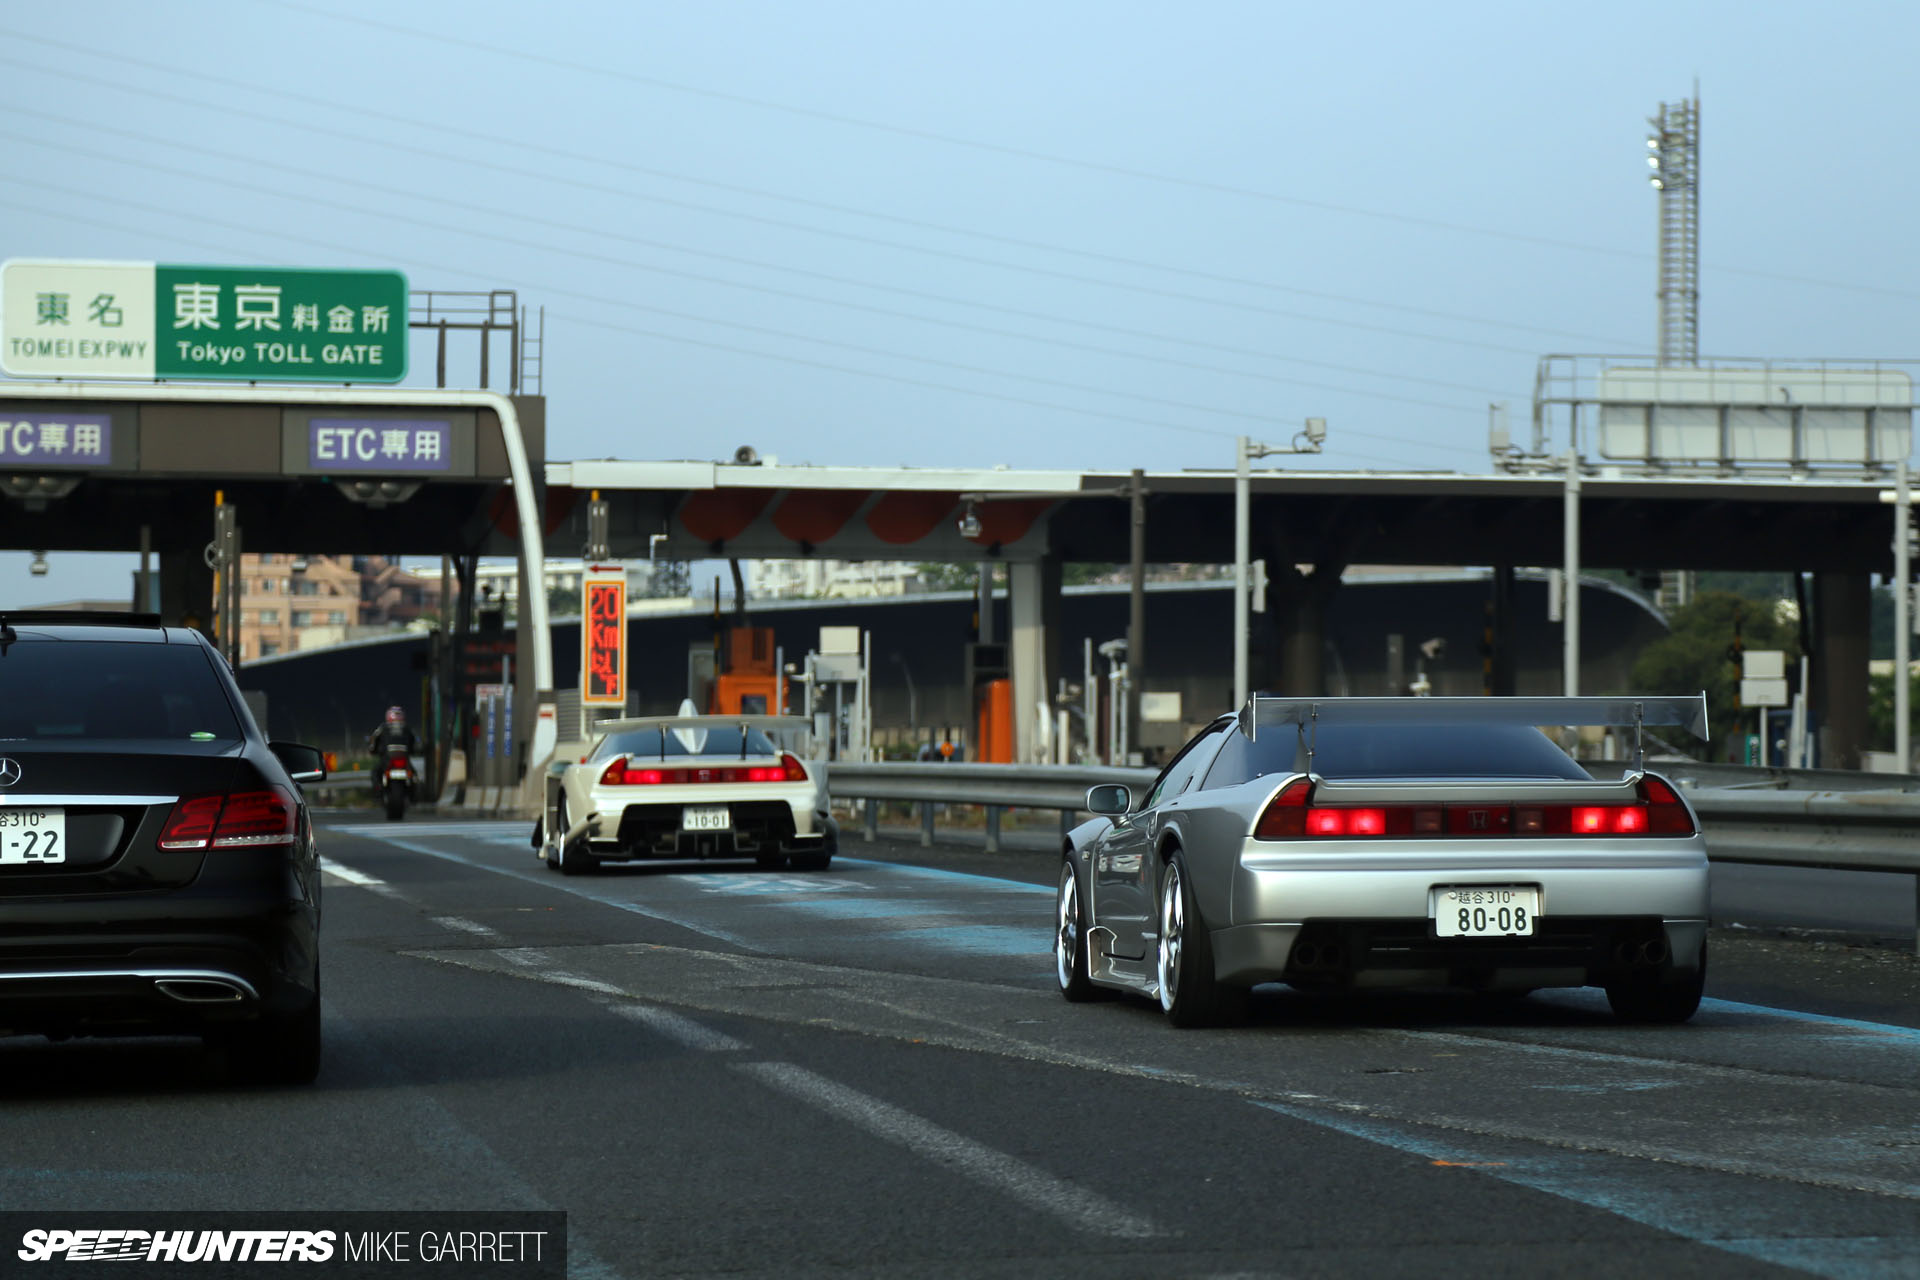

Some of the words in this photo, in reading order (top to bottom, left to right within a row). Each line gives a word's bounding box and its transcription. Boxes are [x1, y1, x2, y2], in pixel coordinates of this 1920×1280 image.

[36, 292, 123, 327] 東名
[173, 283, 390, 334] 東京料金所
[11, 338, 74, 358] TOMEI
[79, 340, 147, 359] EXPWY
[177, 341, 246, 366] Tokyo
[254, 343, 314, 364] TOLL
[322, 345, 383, 365] GATE
[1458, 907, 1526, 931] 80-08
